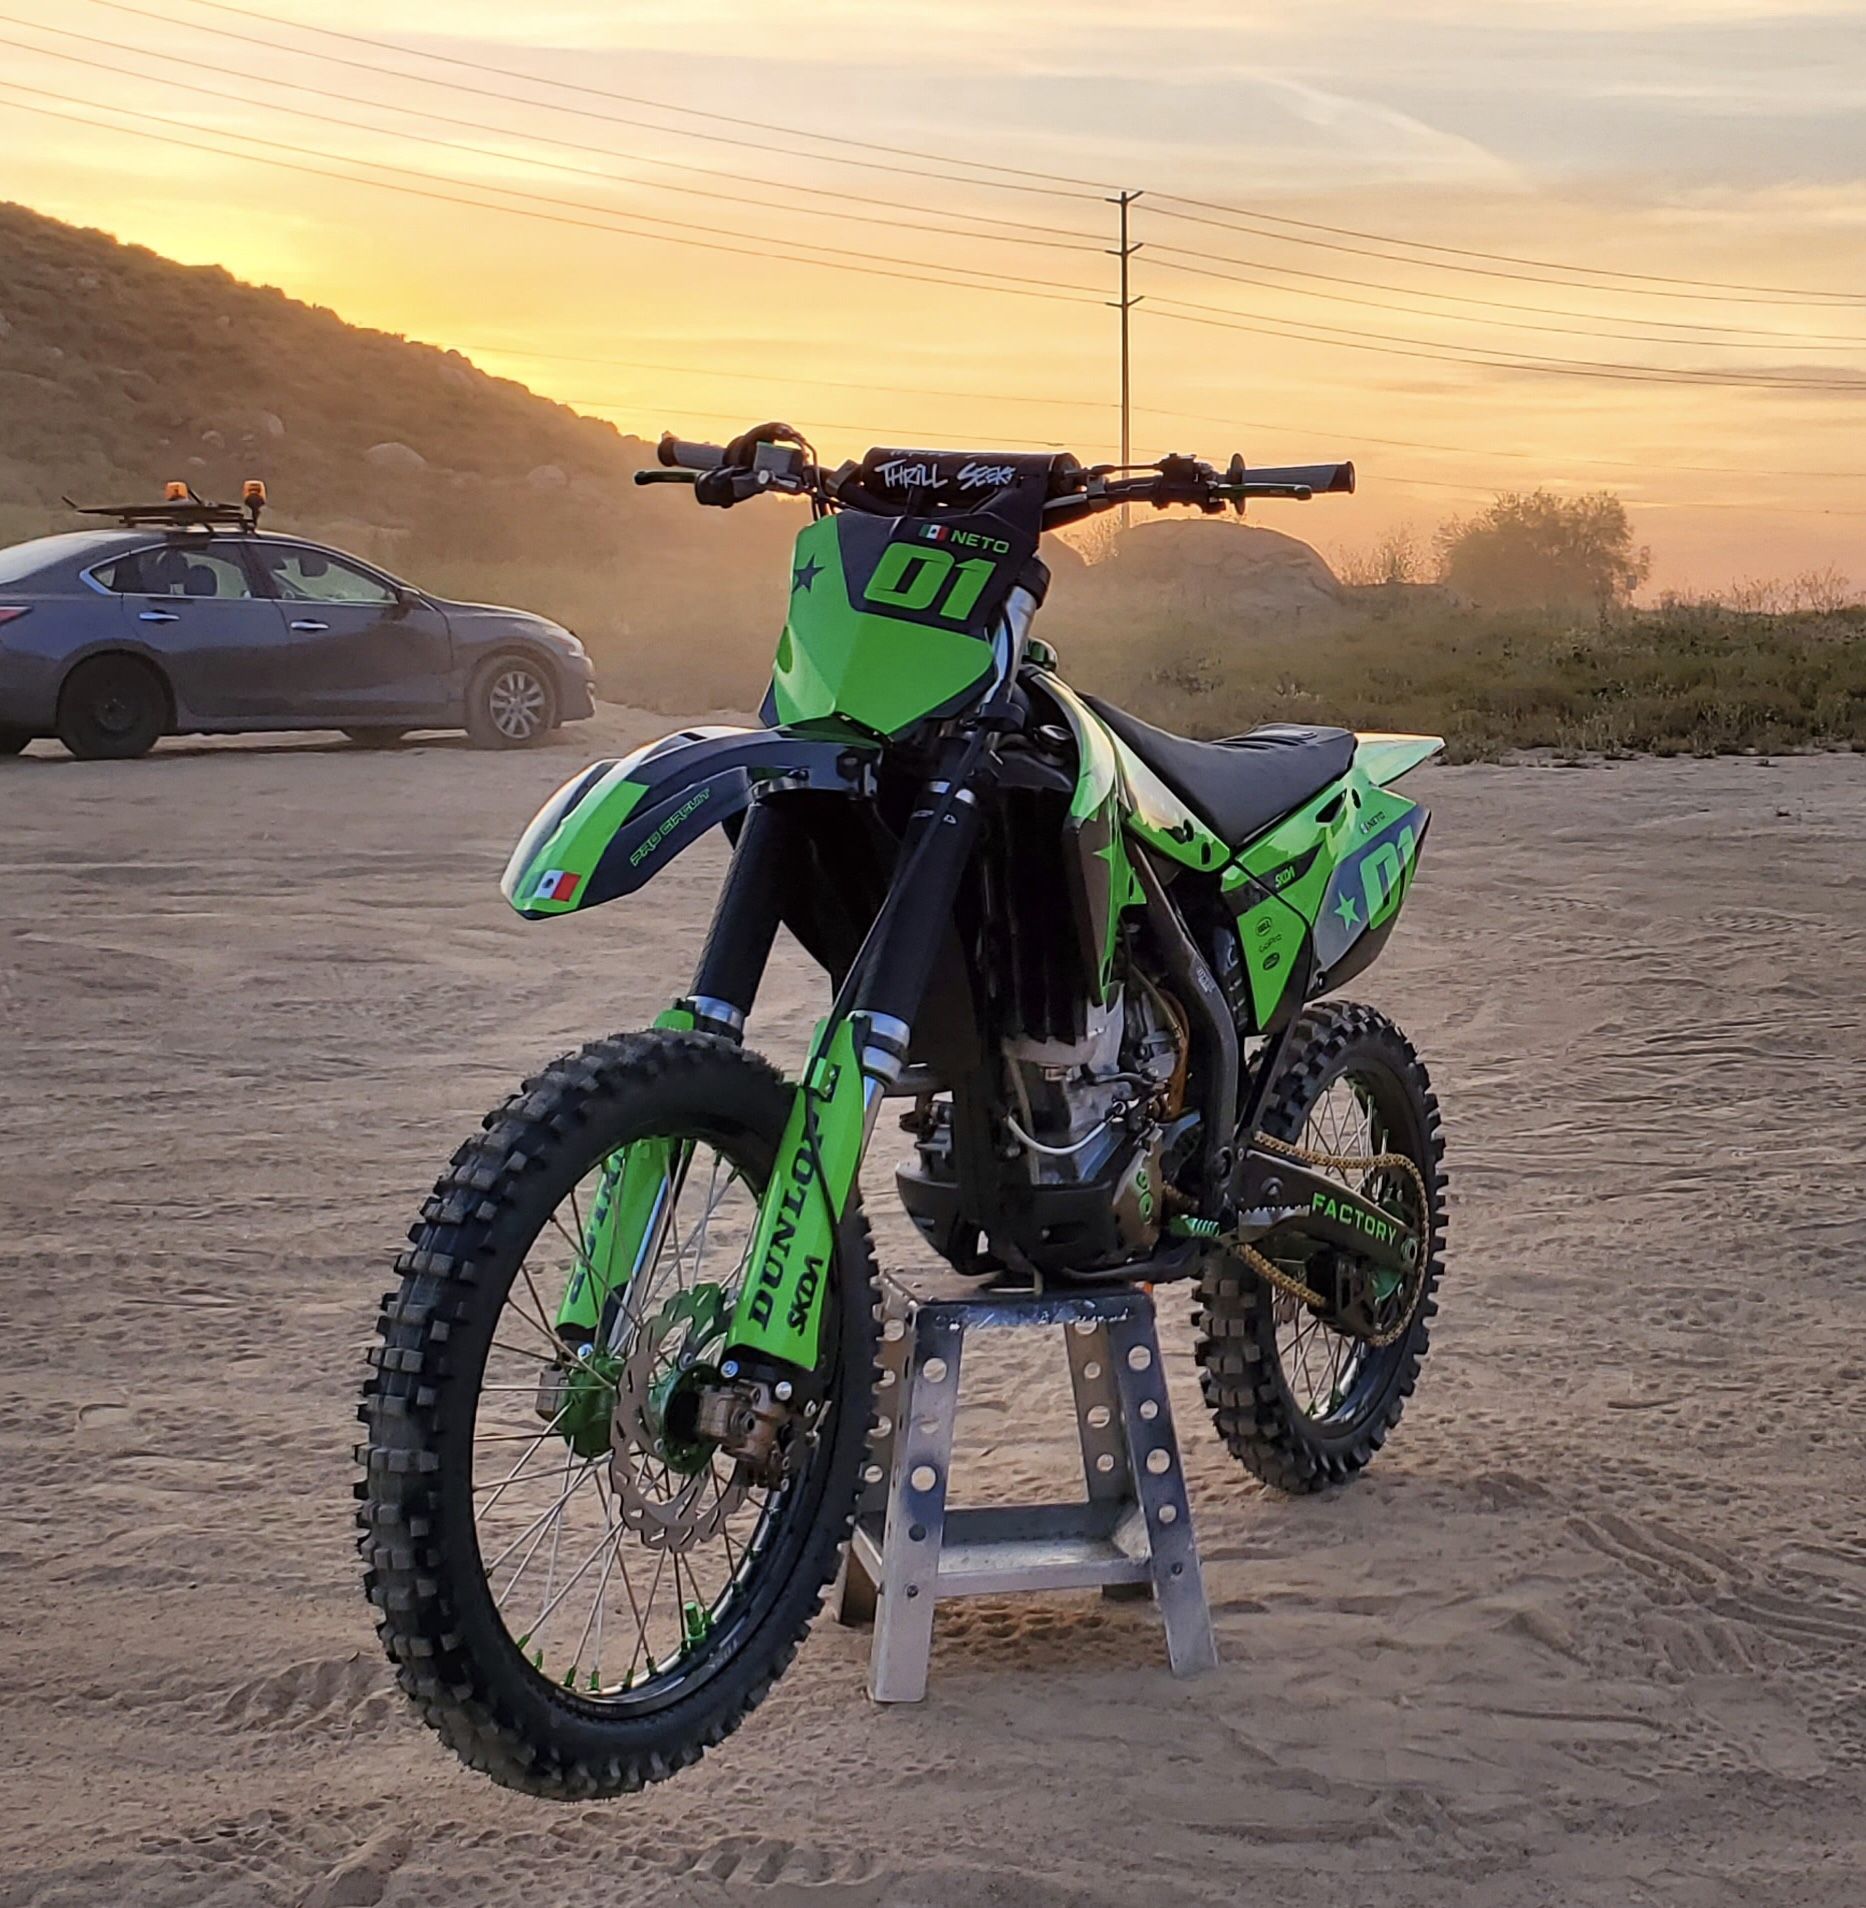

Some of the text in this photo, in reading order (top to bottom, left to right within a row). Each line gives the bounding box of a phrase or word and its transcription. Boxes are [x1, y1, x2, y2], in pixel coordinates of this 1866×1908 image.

[874, 459, 948, 489] THRILL
[950, 530, 1010, 554] NETO
[863, 542, 997, 620] 01
[630, 788, 710, 867] PRO CIRCUIT
[1312, 1191, 1397, 1244] FACTORY
